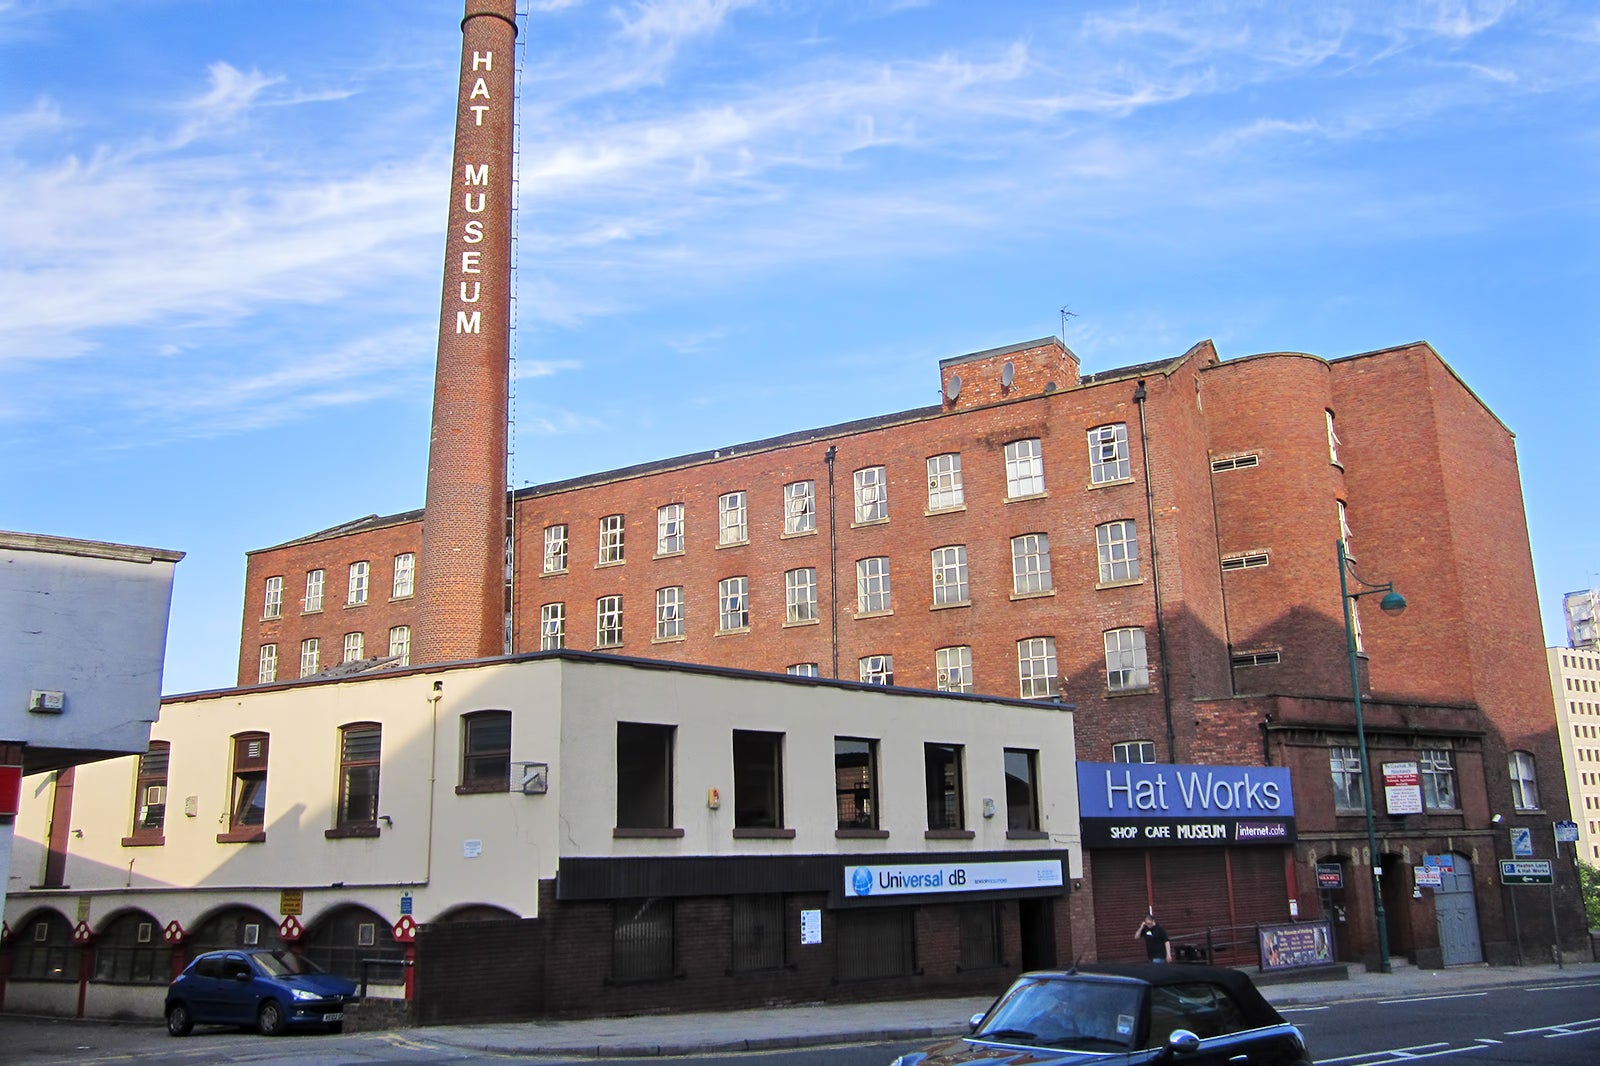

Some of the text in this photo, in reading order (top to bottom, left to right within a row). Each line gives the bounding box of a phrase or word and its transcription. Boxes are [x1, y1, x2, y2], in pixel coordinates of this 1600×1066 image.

[470, 51, 493, 126] HAT
[456, 164, 489, 334] MUSEUM
[1106, 770, 1281, 811] Hat Works
[1111, 827, 1138, 839] SHOP
[1145, 826, 1170, 838] CAFE
[1177, 825, 1226, 839] MUSEUM
[879, 869, 966, 889] Universal dB
